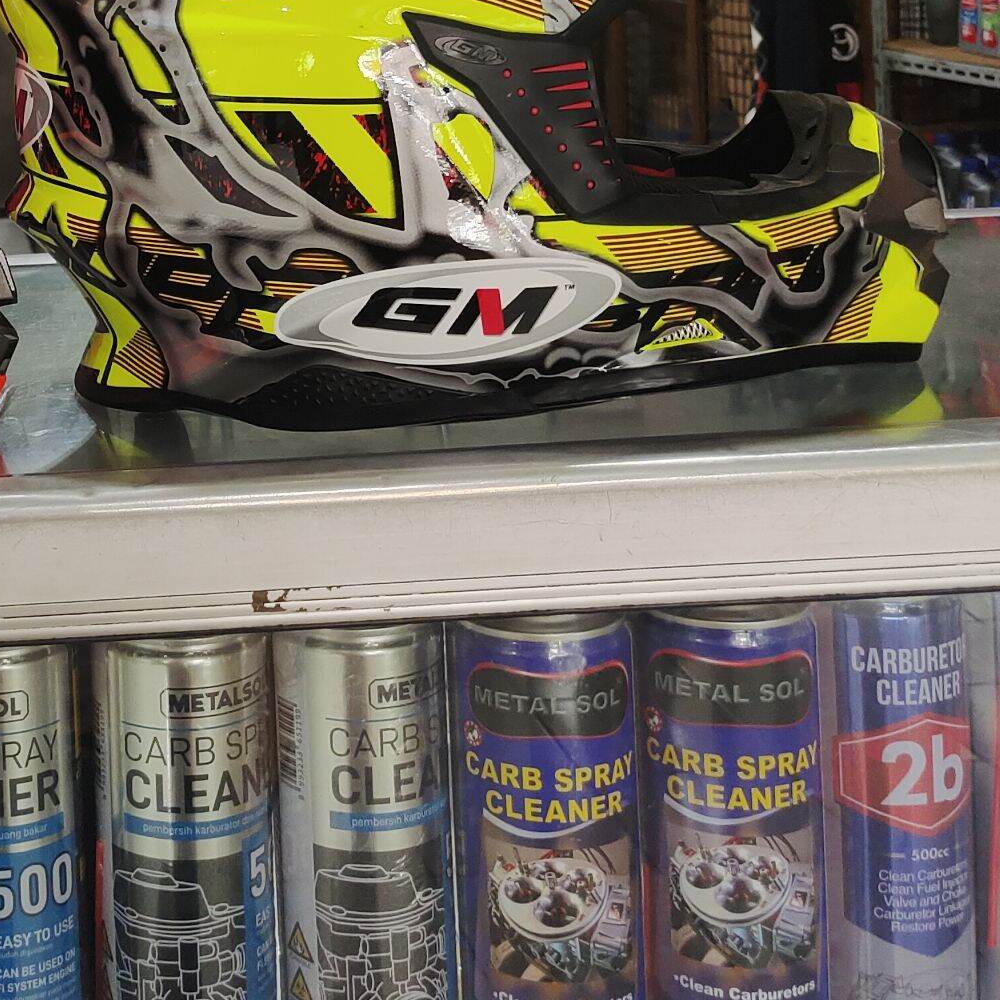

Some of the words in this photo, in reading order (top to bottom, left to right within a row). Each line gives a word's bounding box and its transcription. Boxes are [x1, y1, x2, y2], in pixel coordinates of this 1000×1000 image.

[351, 285, 558, 336] GM
[474, 685, 567, 714] METAL
[575, 688, 620, 714] SOL
[654, 671, 750, 703] METAL
[759, 677, 805, 703] SOL
[876, 671, 960, 706] CLEANER
[124, 731, 216, 767] CARB
[329, 723, 420, 758] CARB
[466, 751, 543, 791] CARB
[554, 750, 633, 793] SPRAY
[646, 736, 725, 778] CARB
[736, 739, 817, 781] SPRAY
[881, 734, 964, 806] 2b
[485, 789, 623, 824] CLEANER
[666, 775, 807, 811] CLEANER
[911, 847, 949, 862] 500cc
[877, 882, 914, 895] Clean
[917, 882, 940, 894] Fuel
[878, 869, 915, 882] Clean
[873, 907, 936, 920] Carburetor
[883, 894, 917, 908] Valve
[919, 894, 940, 906] and
[34, 927, 50, 944] TO
[53, 914, 74, 936] USE
[891, 920, 936, 933] Restore
[7, 976, 47, 994] SYSTEM
[49, 961, 77, 984] ENGINE
[21, 964, 36, 977] BE
[38, 955, 64, 973] USED
[65, 947, 76, 961] ON
[679, 975, 724, 997] Clean
